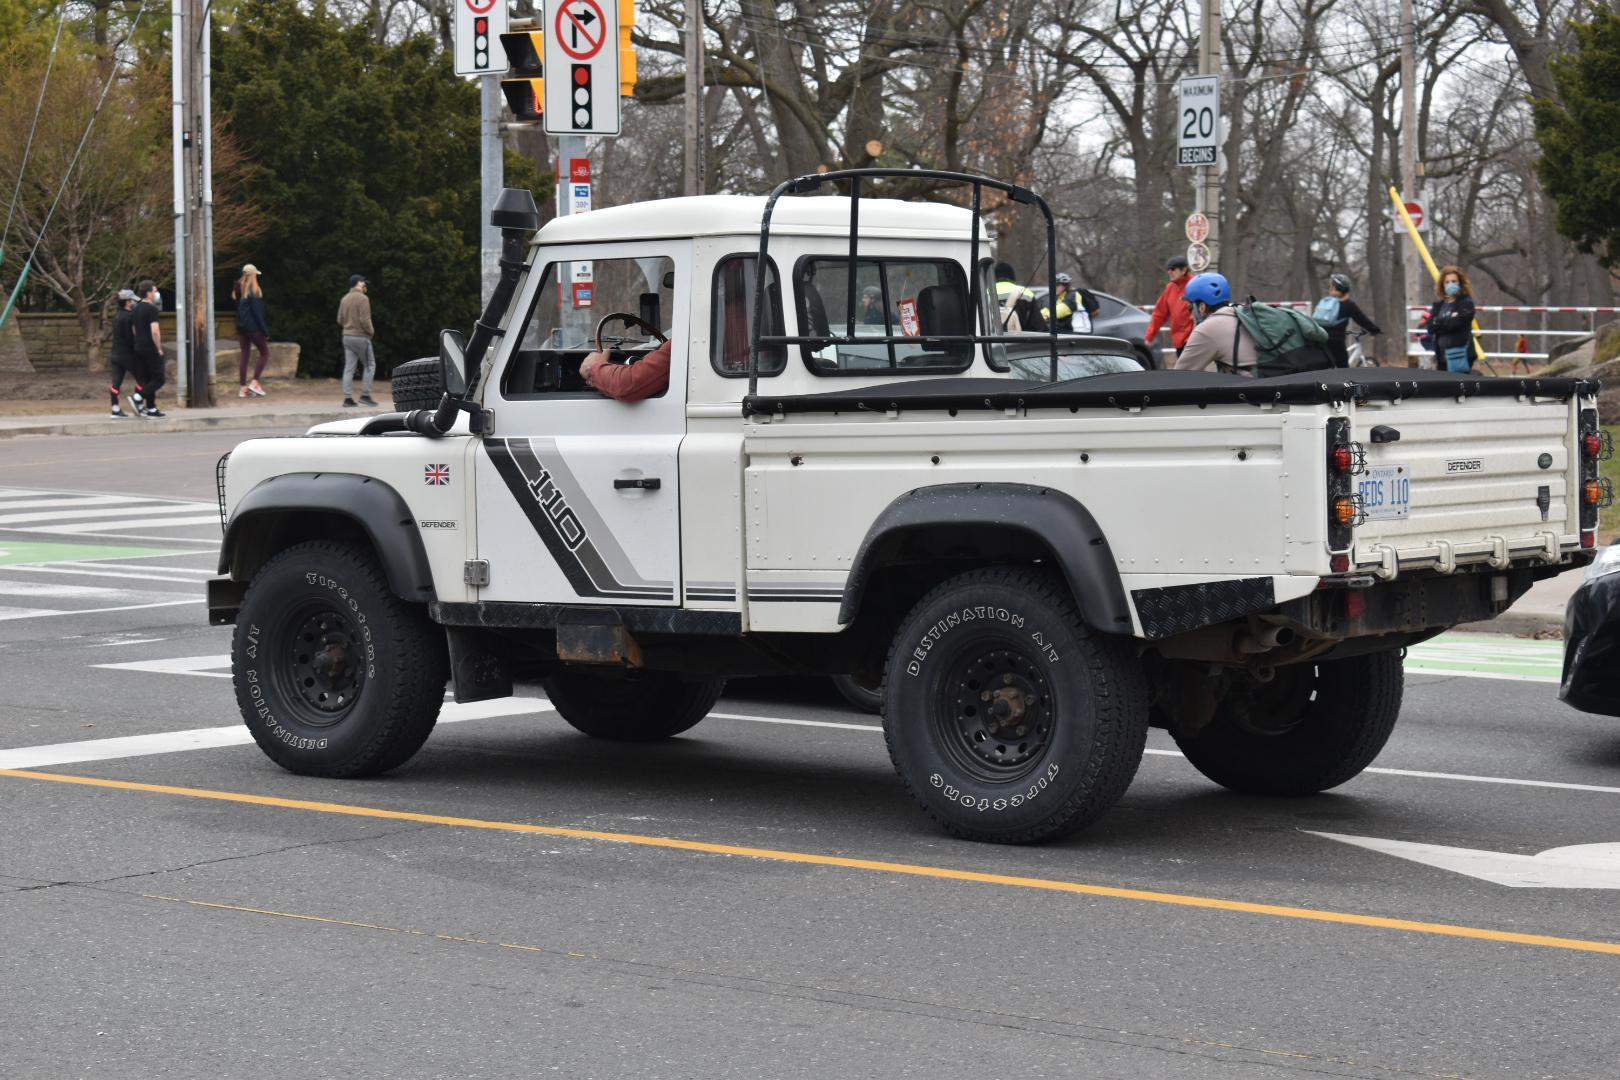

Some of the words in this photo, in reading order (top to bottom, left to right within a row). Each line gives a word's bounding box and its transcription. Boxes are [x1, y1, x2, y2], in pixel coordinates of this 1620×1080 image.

[1183, 85, 1213, 96] MAXIMUM
[1183, 107, 1213, 139] 20
[1182, 147, 1213, 162] BEGINS
[1447, 460, 1481, 471] DEFENDER
[1391, 479, 1408, 504] 110
[527, 469, 587, 552] 110
[247, 624, 260, 659] A/T
[907, 606, 1024, 676] DESTINATION
[1032, 632, 1059, 662] A/T
[246, 669, 328, 750] DESTINATION
[930, 763, 1059, 811] Firestone
